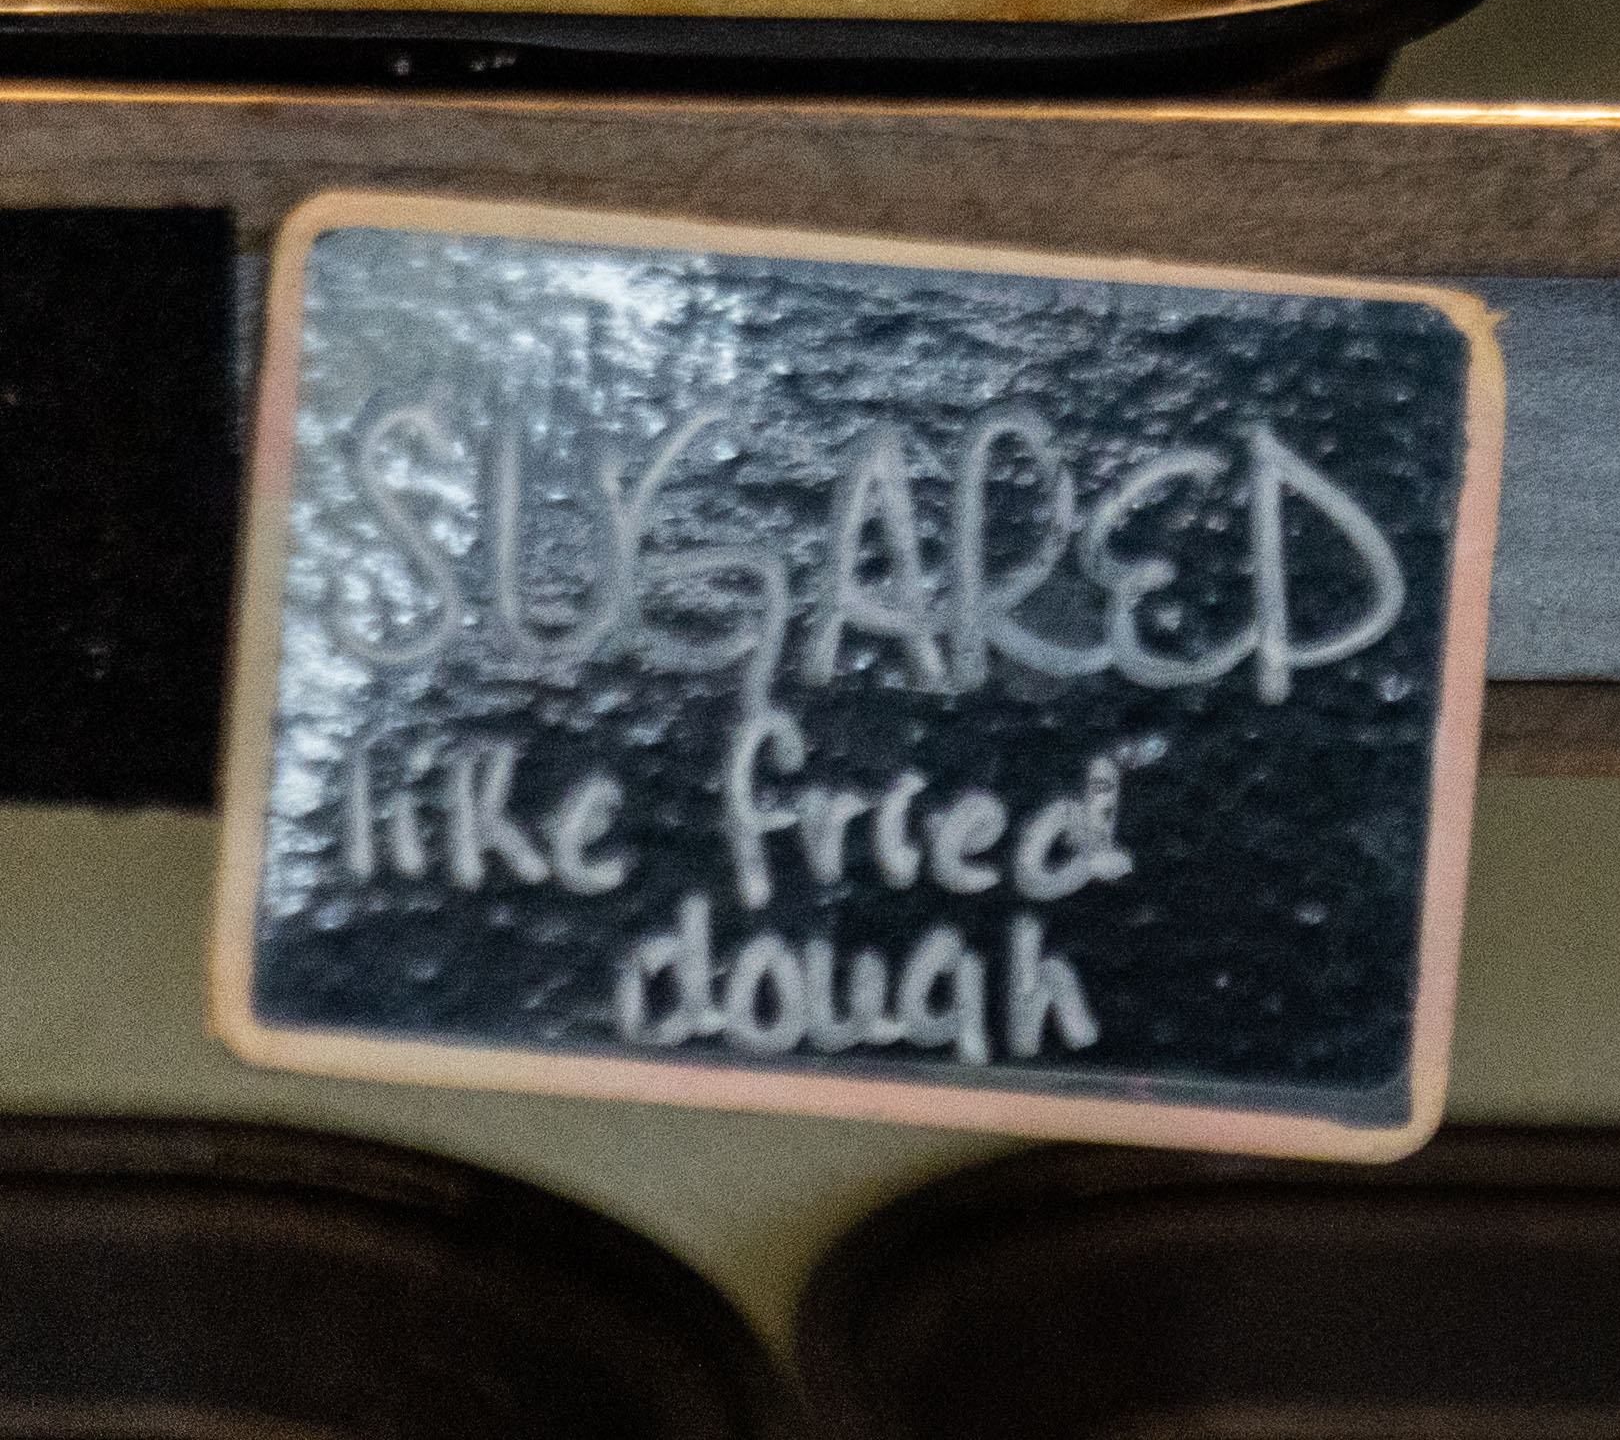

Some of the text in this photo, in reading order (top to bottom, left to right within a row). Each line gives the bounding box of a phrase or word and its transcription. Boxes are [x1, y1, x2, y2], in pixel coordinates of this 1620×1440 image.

[330, 396, 1405, 721] SUGARED
[344, 715, 1145, 907] like fried
[620, 893, 1100, 1064] dough
